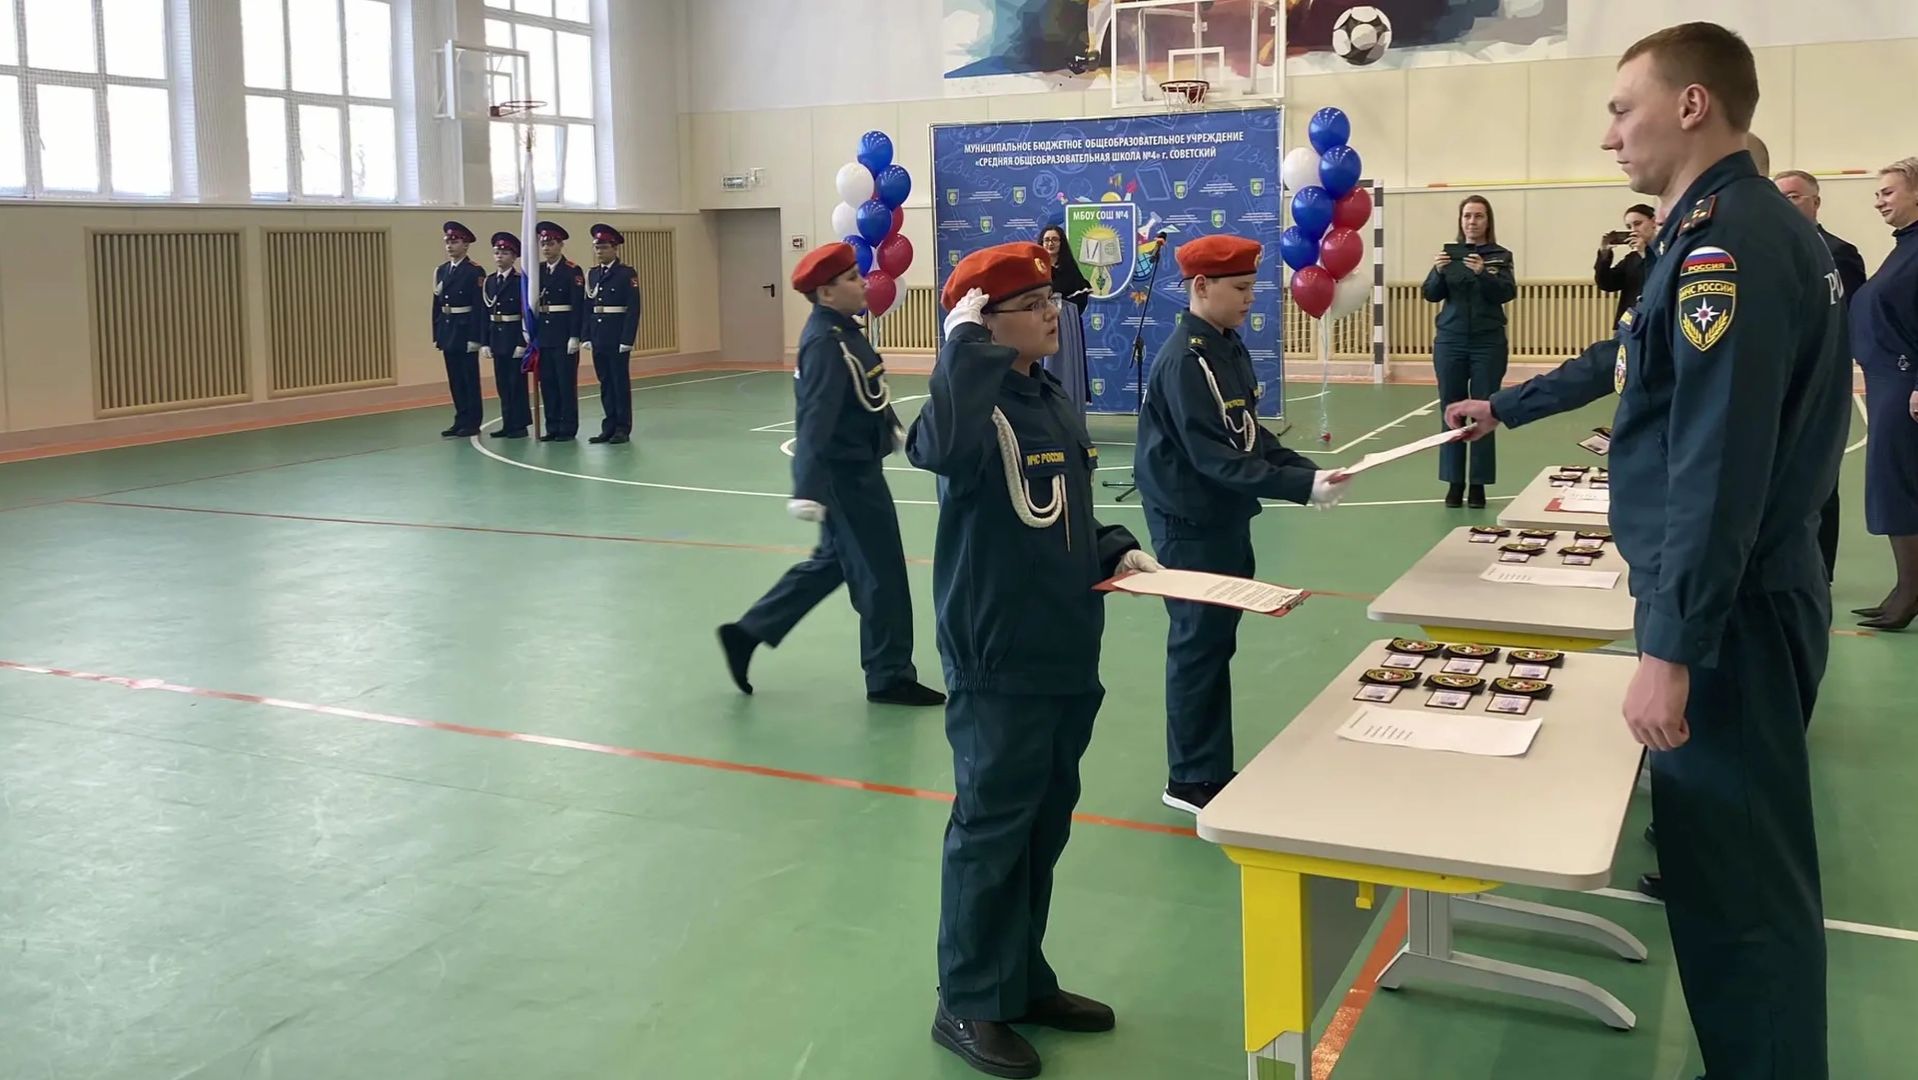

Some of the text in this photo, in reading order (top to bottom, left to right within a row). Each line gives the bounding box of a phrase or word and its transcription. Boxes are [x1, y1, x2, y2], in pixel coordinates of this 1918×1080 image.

[964, 131, 1244, 154] МУНИЦИПАЛЬНОЕ БЮДЖЕТНОЕ ОБЩЕОБРАЗОВАТЕЛЬНОЕ УЧРЕЖДЕНИЕ
[1014, 151, 1111, 166] ОБЩЕОБРАЗОВАТЕЛЬНАЯ
[1111, 150, 1141, 162] ШКОЛА
[1169, 146, 1217, 159] СОВЕТСКИЙ
[1073, 211, 1129, 220] МБОУ СОШ №4
[1688, 263, 1725, 272] РОССИЯ
[1697, 283, 1734, 294] РОССИИ
